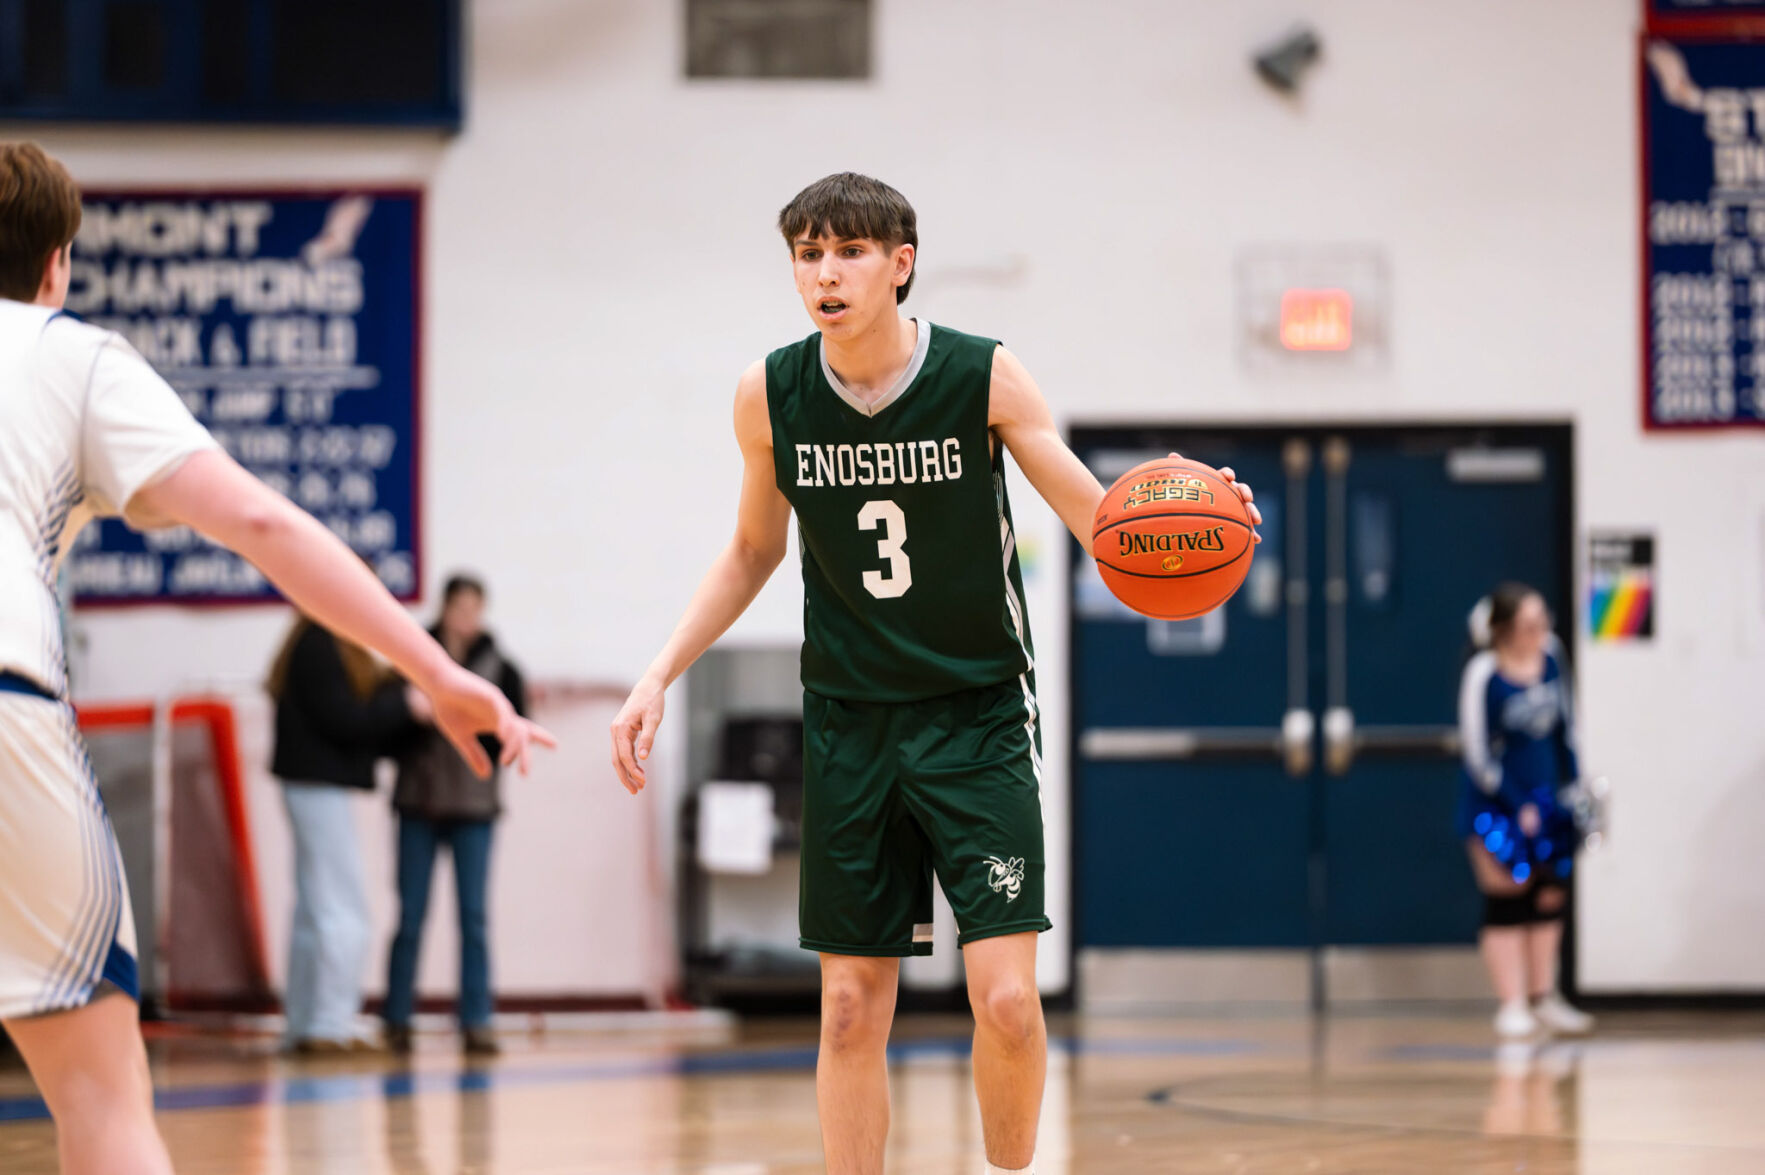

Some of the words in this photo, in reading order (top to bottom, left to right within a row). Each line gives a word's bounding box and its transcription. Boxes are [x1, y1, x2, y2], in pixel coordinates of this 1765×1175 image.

[80, 202, 272, 256] MONT
[795, 437, 963, 487] ENOSBURG
[1123, 487, 1214, 510] LEGACY
[857, 500, 912, 599] 3
[1119, 526, 1225, 556] SPALDING
